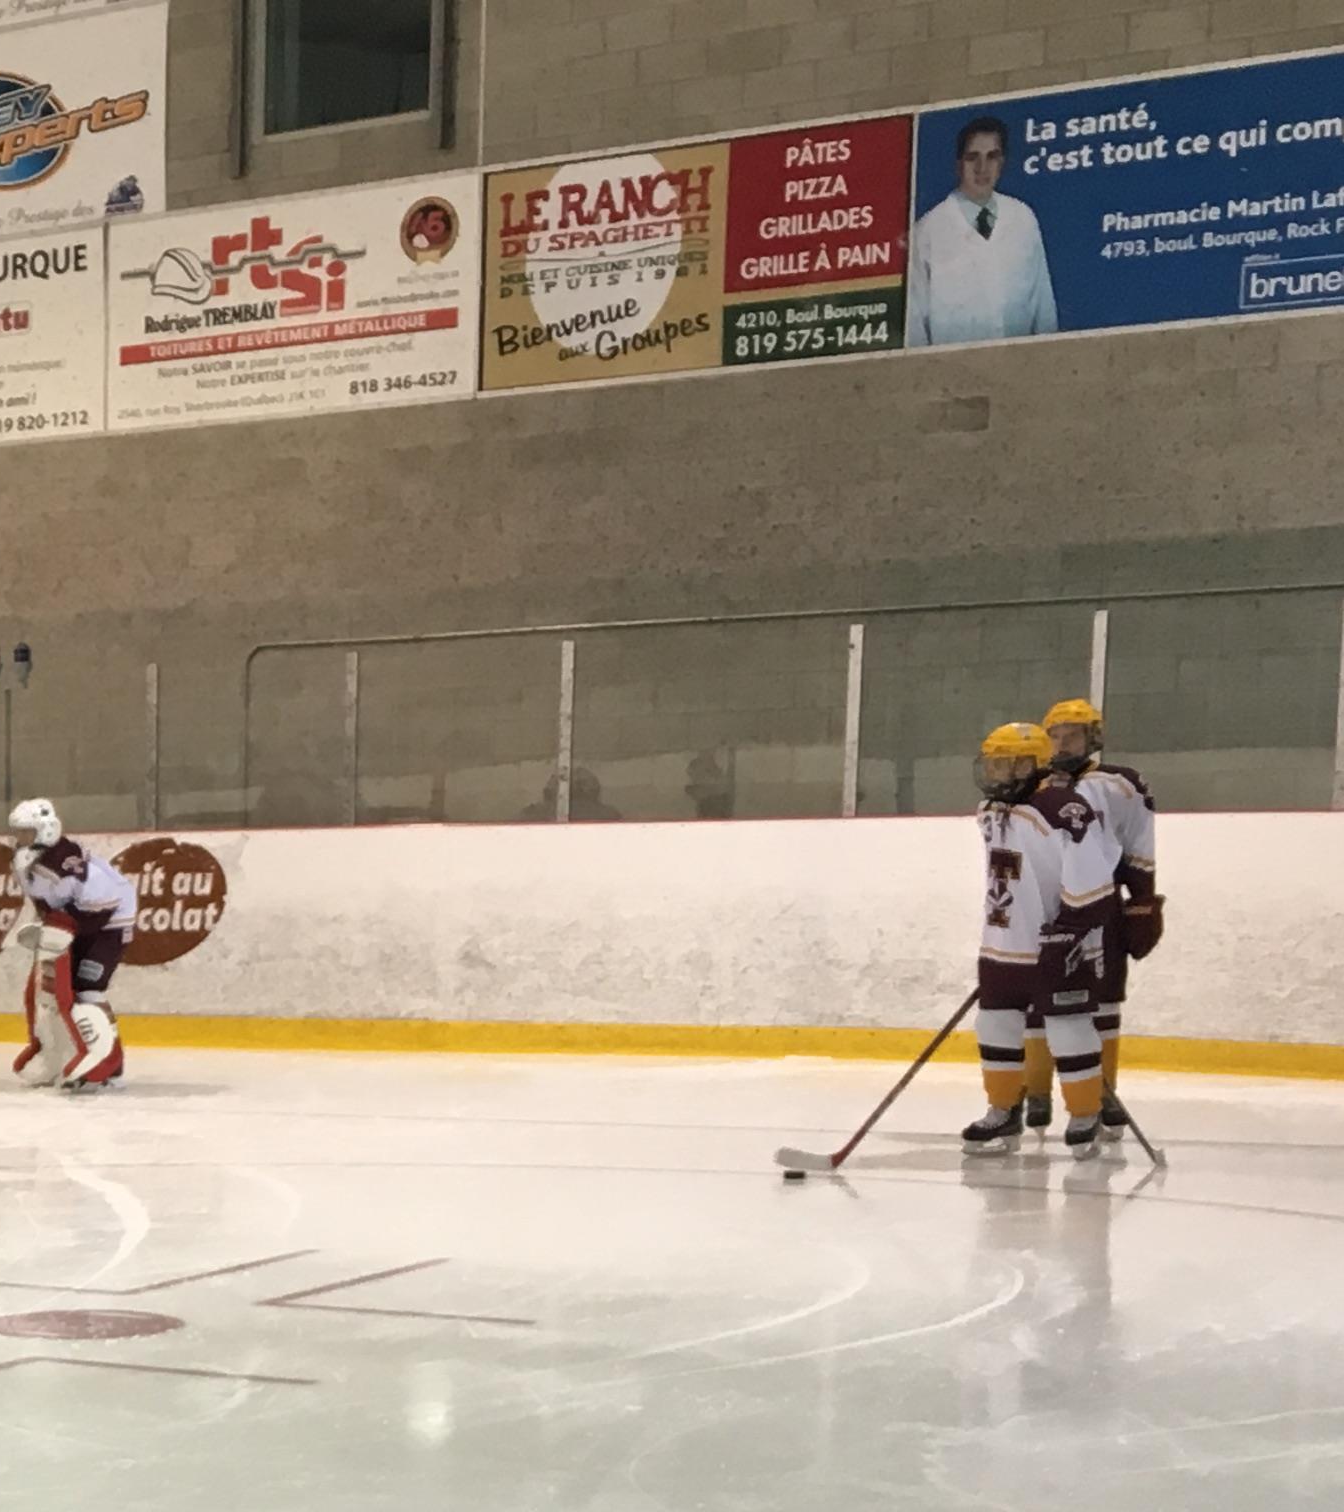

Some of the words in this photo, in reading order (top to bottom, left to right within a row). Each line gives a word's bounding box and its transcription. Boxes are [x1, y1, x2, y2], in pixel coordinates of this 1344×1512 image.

[1026, 118, 1058, 143] La
[1065, 103, 1157, 138] santé,
[785, 138, 851, 168] PÂTES
[1023, 145, 1093, 175] c'est
[1101, 136, 1168, 165] tout
[1176, 135, 1210, 157] ce
[1218, 119, 1268, 157] qui
[1276, 117, 1344, 144] com
[500, 184, 549, 238] LE
[558, 166, 714, 230] RANCH
[785, 174, 849, 202] PIZZA
[759, 205, 873, 240] GRILLADES
[1102, 202, 1221, 233] Pharmacie
[1227, 192, 1305, 218] Martin
[501, 234, 541, 258] DU
[548, 215, 710, 252] SPAGHETTI
[1101, 239, 1150, 260] 4793,
[1287, 217, 1331, 238] Rock
[740, 253, 811, 280] GRILLE
[814, 244, 832, 271] À
[837, 242, 890, 269] PAIN
[1250, 269, 1344, 299] brune
[144, 313, 202, 335] Rodrigue
[203, 301, 278, 327] TREMBLAY
[493, 297, 641, 357] Bienvenue
[823, 300, 888, 325] Bourque
[150, 338, 212, 358] TOITURES
[216, 335, 233, 351] ET
[558, 341, 592, 361] aux
[594, 313, 710, 362] Groupes
[735, 332, 777, 357] 819
[783, 319, 889, 352] 575-1444
[192, 360, 232, 375] SAVOIR
[230, 369, 286, 386] EXPERTISE
[349, 380, 378, 395] 818
[383, 370, 458, 392] 346-4527
[16, 410, 89, 431] 820-1212
[172, 871, 213, 897] au
[137, 900, 218, 931] colat
